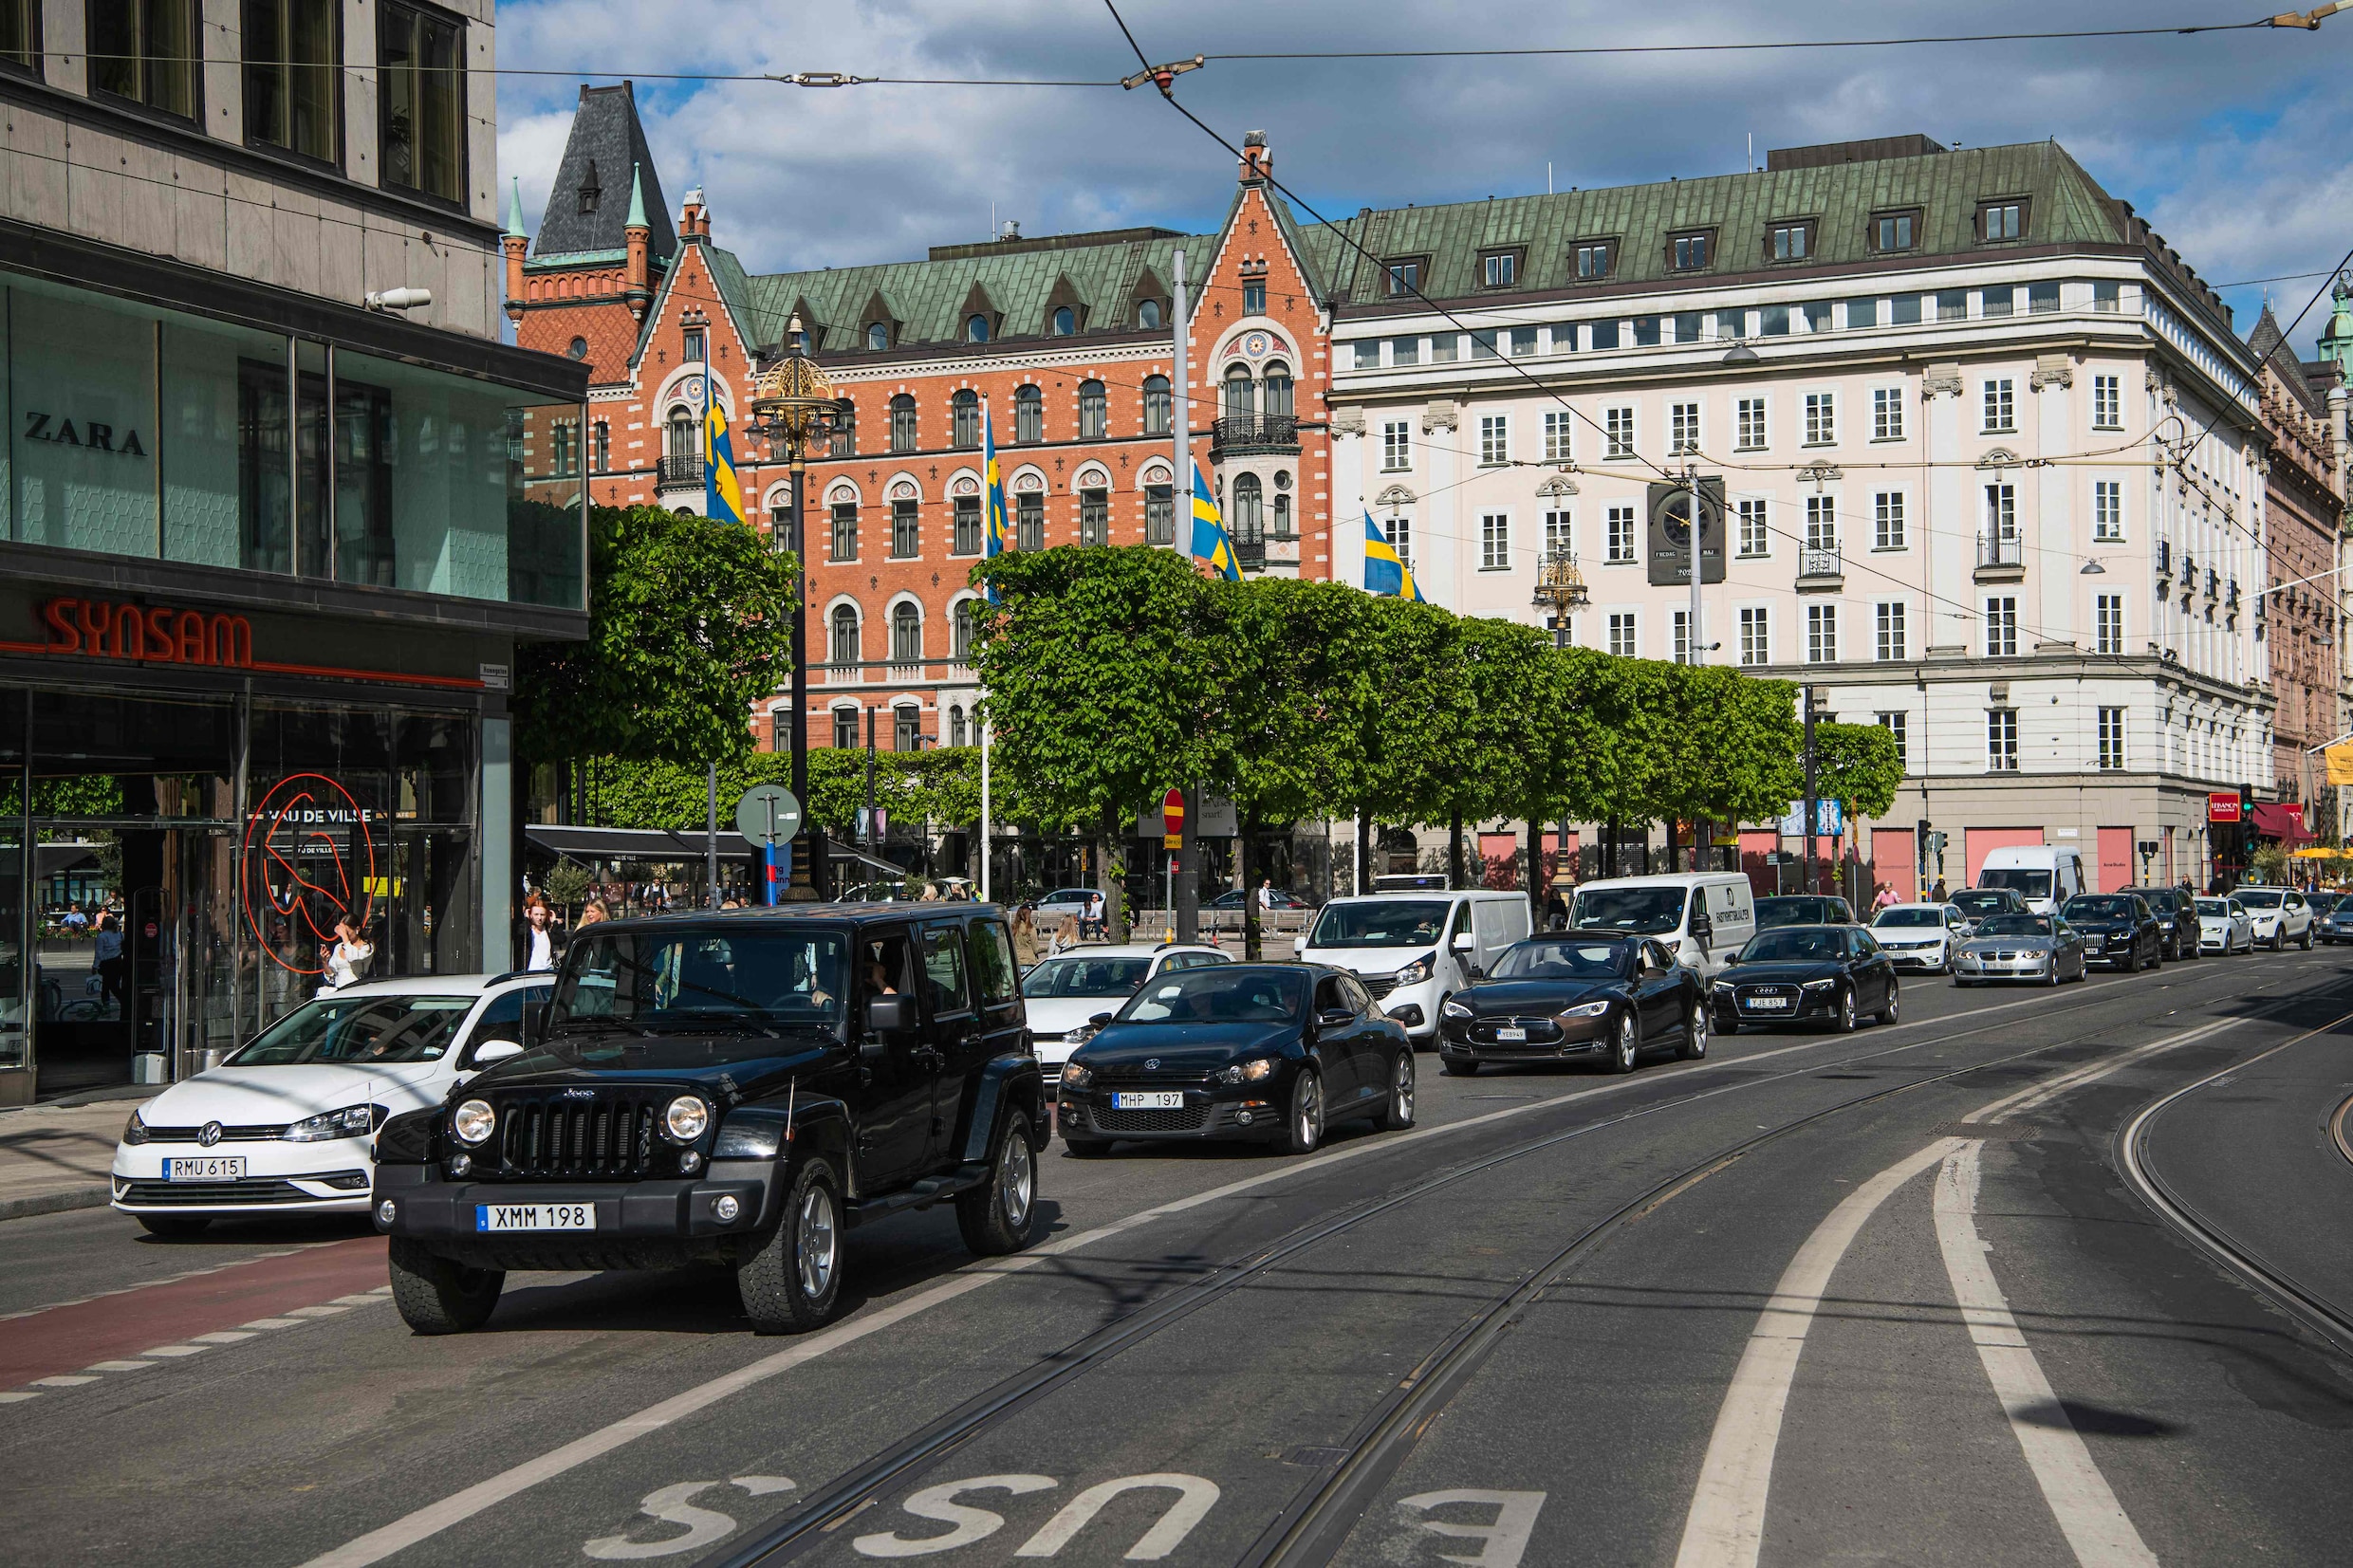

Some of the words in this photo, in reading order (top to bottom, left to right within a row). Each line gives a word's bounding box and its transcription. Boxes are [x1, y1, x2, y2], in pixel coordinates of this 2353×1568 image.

[25, 412, 147, 456] ZARA
[46, 597, 252, 669] SYNSAM
[304, 809, 324, 822] DE
[327, 809, 372, 822] VILLE
[564, 1087, 595, 1099] Jeep
[1121, 1094, 1144, 1106] MHP
[1156, 1094, 1179, 1106] 197
[175, 1160, 203, 1175] RMU
[208, 1160, 238, 1175] 615
[496, 1208, 537, 1227] XMM
[547, 1207, 585, 1227] 198
